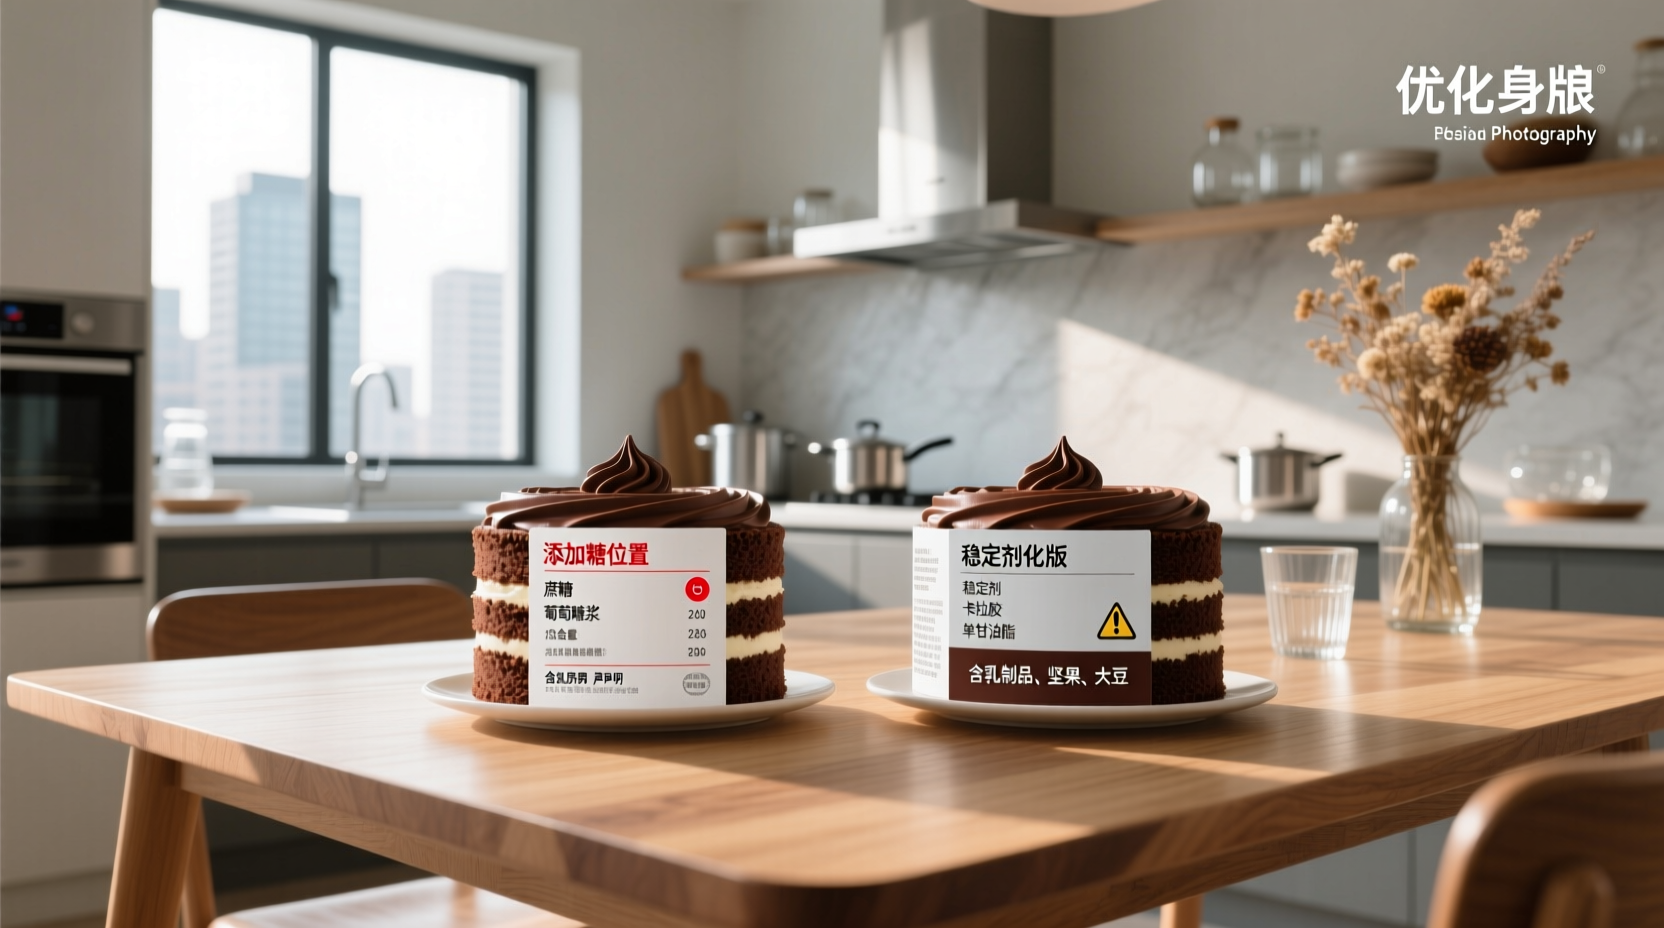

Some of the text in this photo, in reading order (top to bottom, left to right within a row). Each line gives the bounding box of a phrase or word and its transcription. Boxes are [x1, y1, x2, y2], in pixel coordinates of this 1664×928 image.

[543, 542, 649, 566] 添加糖位置
[961, 543, 1067, 568] 稳定剂化版
